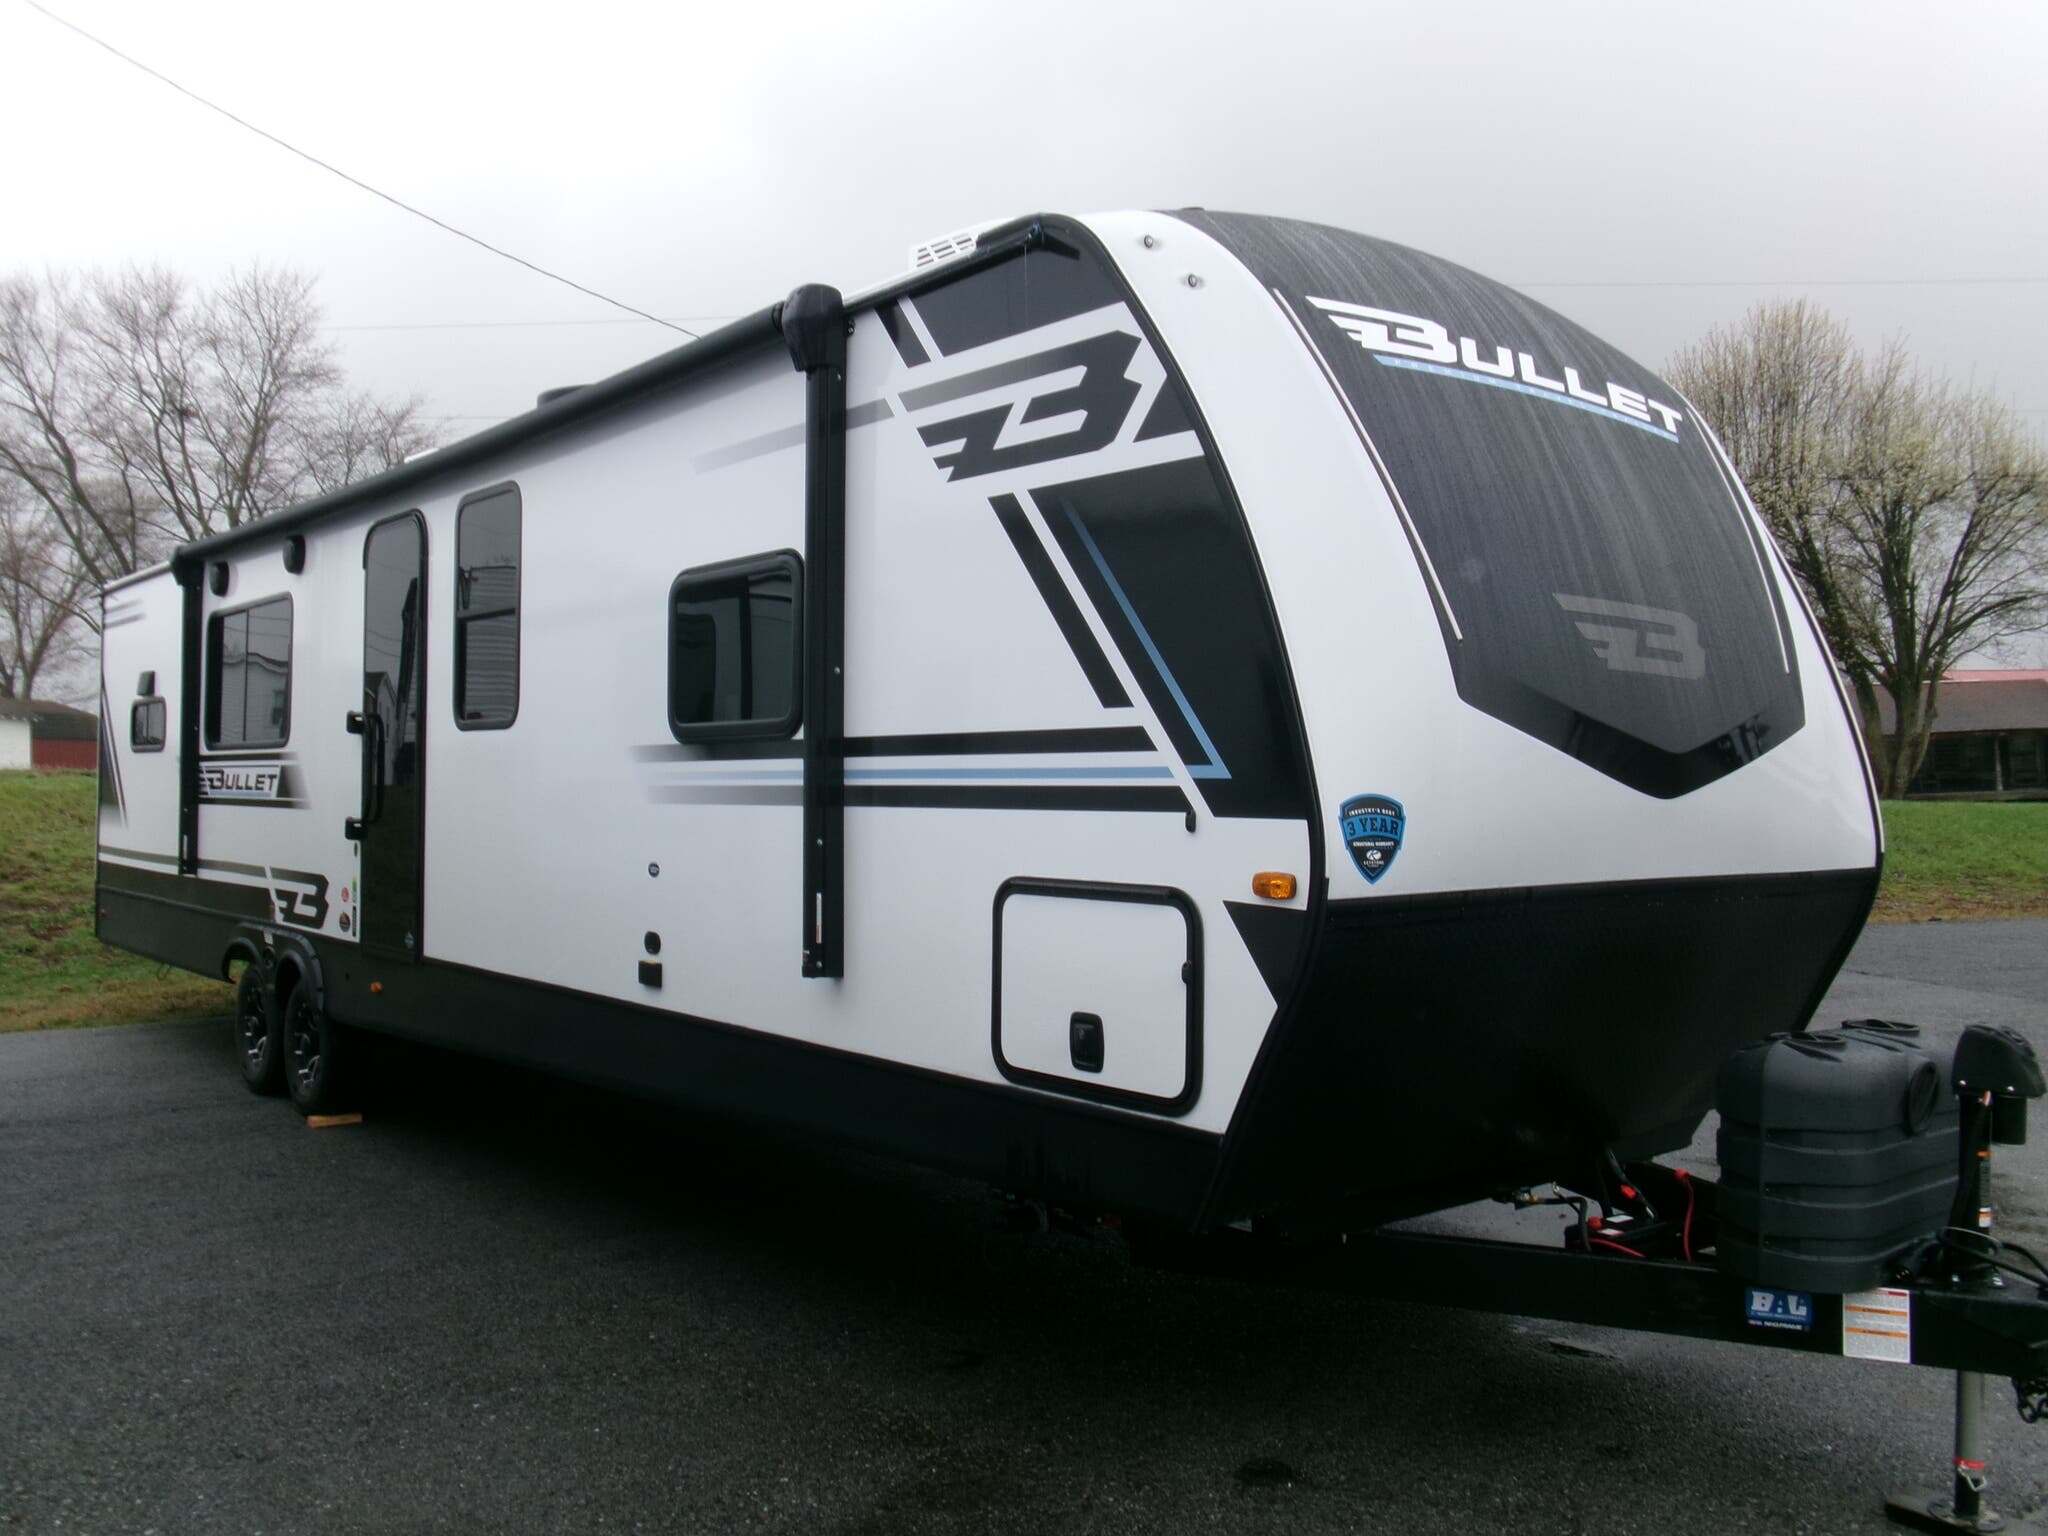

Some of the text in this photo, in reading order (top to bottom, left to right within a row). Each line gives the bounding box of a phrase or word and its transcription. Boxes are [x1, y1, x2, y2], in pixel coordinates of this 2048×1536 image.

[1305, 296, 1683, 434] BULLET
[204, 769, 277, 792] BULLET
[1347, 816, 1399, 836] 3 YEAR
